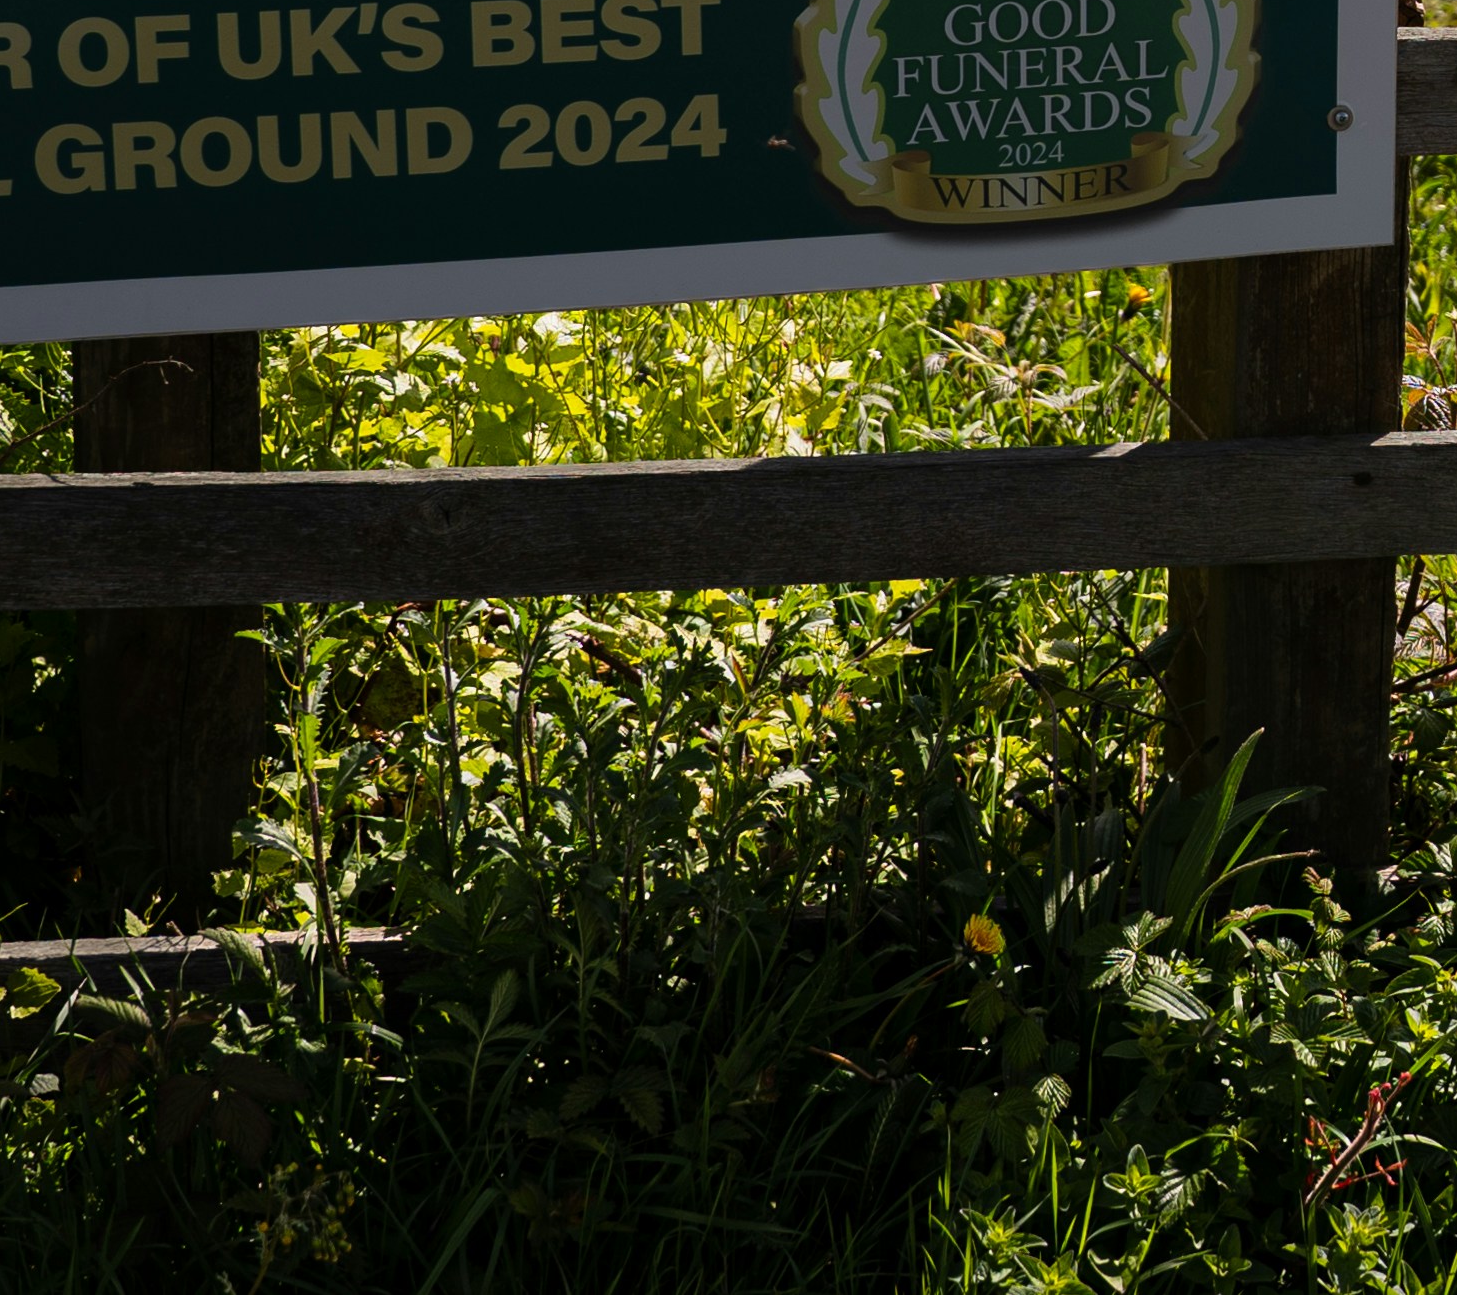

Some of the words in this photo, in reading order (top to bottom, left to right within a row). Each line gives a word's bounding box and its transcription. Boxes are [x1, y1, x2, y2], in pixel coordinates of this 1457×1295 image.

[57, 14, 191, 88] OF
[216, 2, 444, 80] UK'S
[893, 39, 1169, 98] FUNERAL
[34, 106, 474, 195] GROUND
[497, 93, 728, 170] 2024
[906, 86, 1152, 145] AWARDS
[998, 140, 1065, 168] 2024
[929, 162, 1133, 209] WINNER
